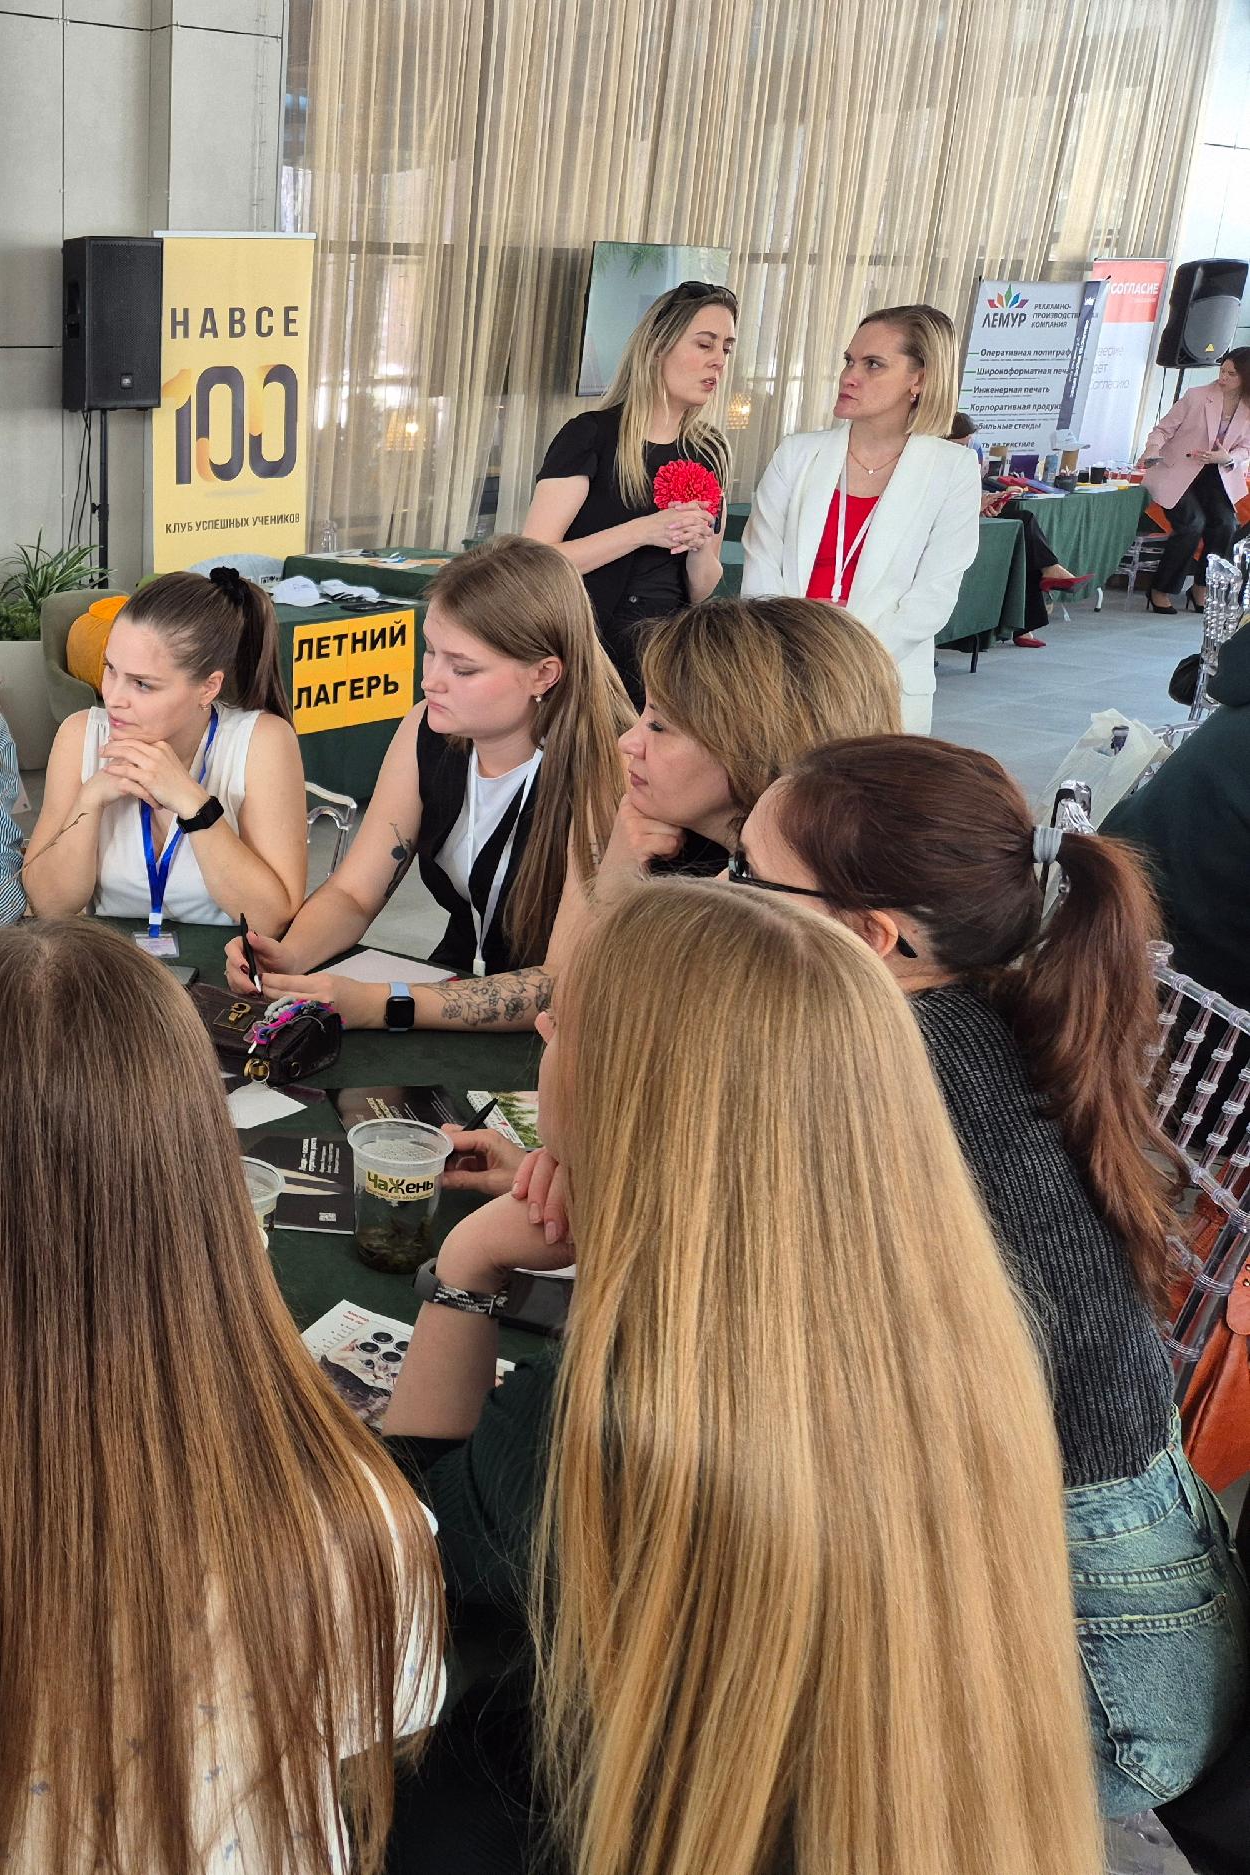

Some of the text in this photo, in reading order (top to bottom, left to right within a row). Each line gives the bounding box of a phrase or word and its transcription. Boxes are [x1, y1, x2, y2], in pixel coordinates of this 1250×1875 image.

[1111, 282, 1159, 294] СОГЛАСИЕ
[170, 306, 299, 339] НАВСЕ
[982, 313, 1027, 328] ЛЕМУР
[980, 349, 1031, 358] Оперативная
[977, 367, 1051, 376] Широкоформатная
[973, 386, 1022, 394] Инженерная
[970, 403, 1031, 412] Корпоративная
[162, 364, 298, 485] 100
[165, 513, 300, 534] КЛУБ УСПЕШНЫХ УЧЕНИКОВ
[294, 619, 406, 663] ЛЕТНИЙ
[294, 674, 399, 711] ЛАГЕРЬ
